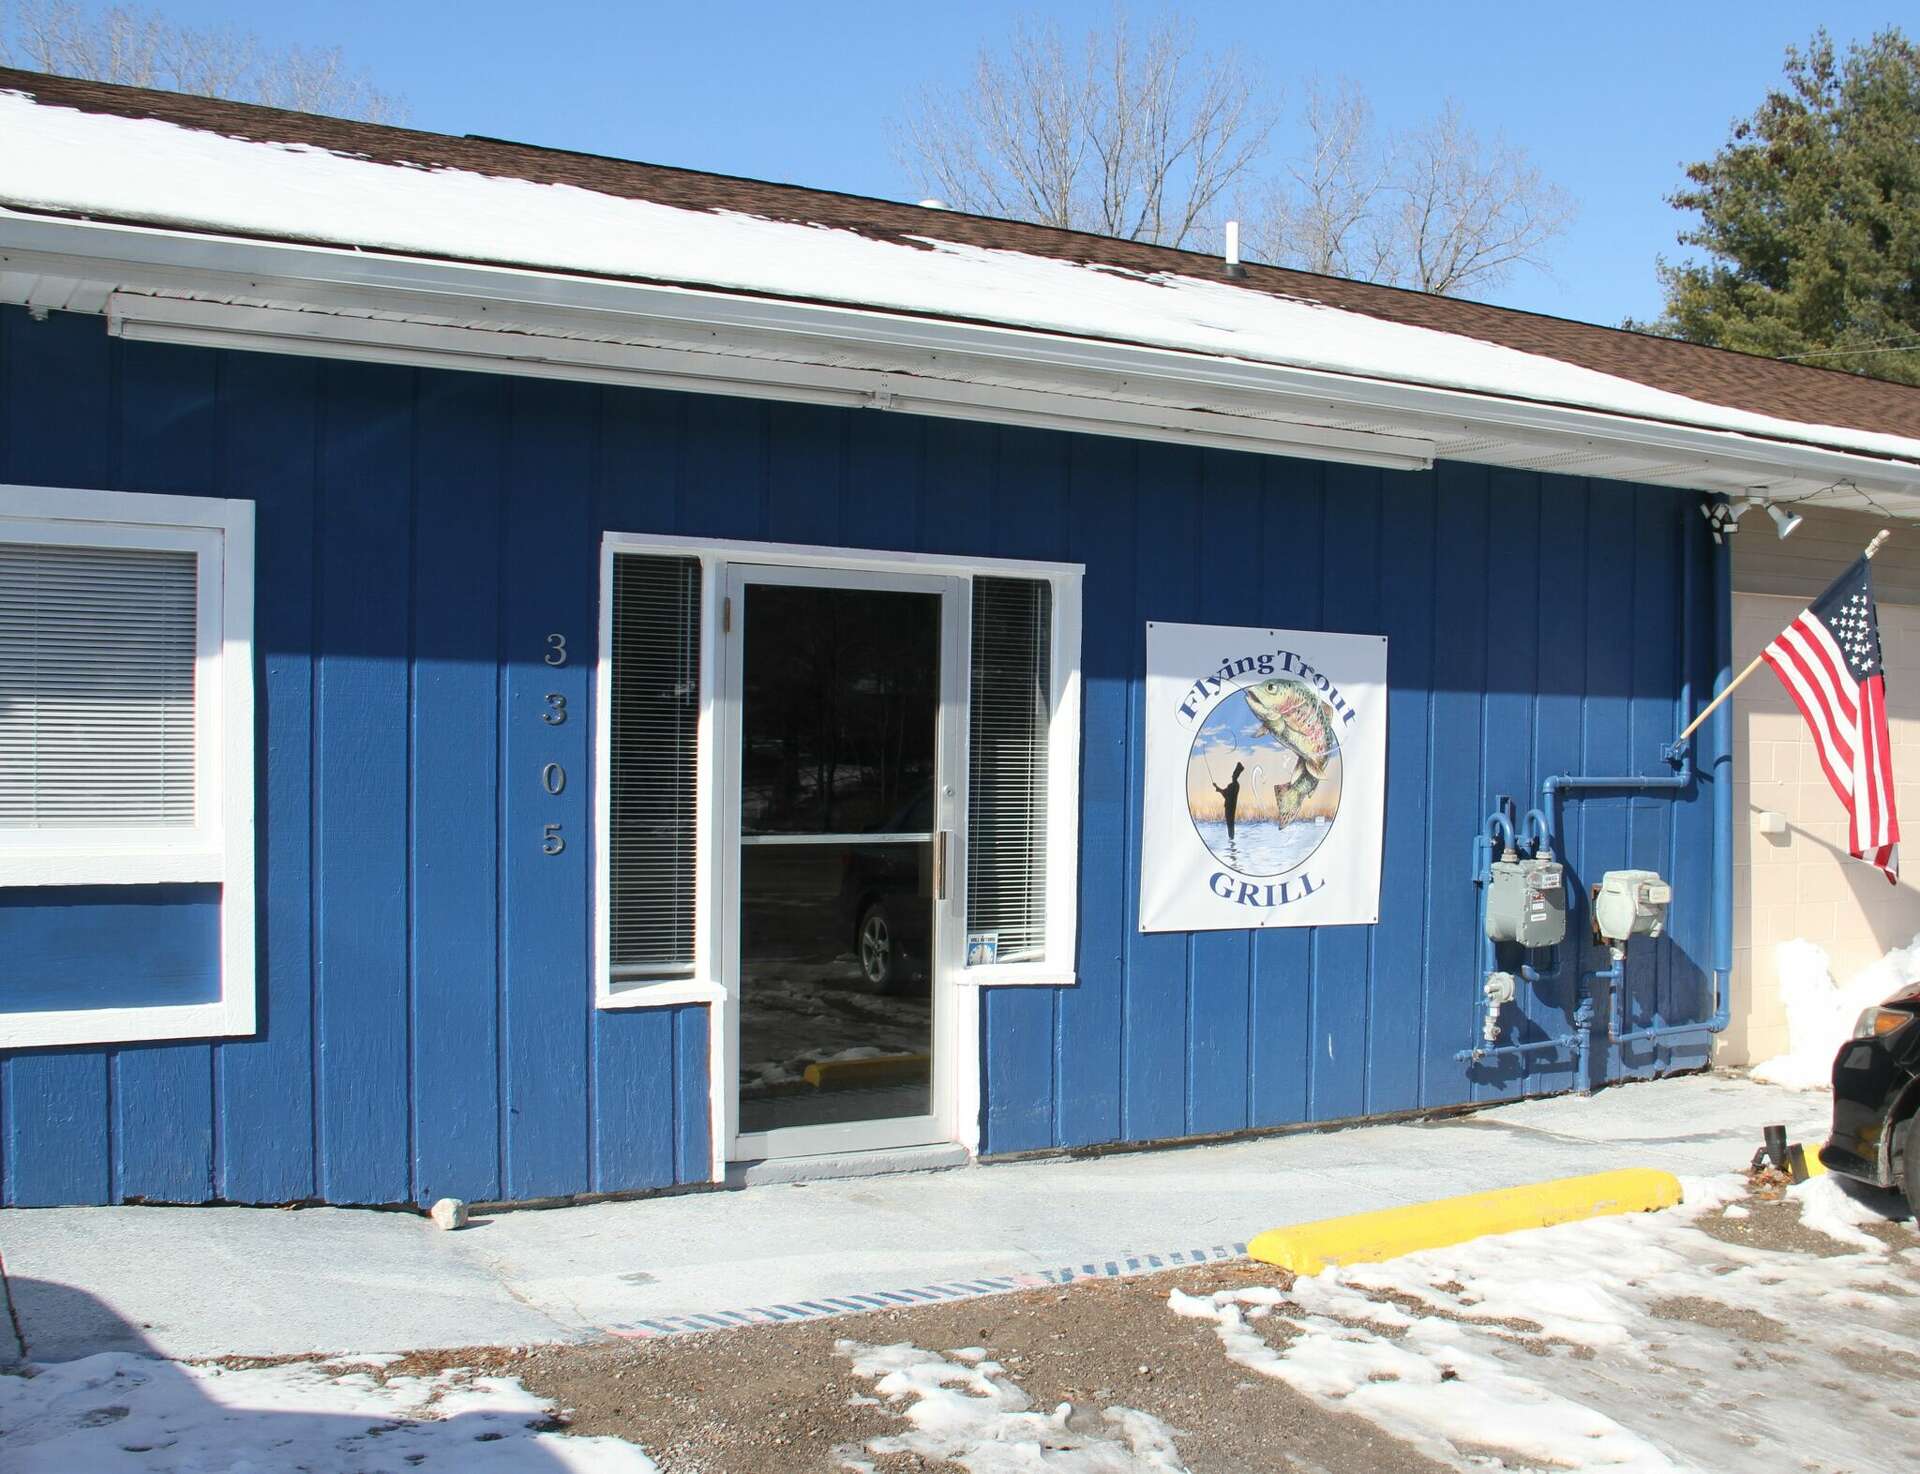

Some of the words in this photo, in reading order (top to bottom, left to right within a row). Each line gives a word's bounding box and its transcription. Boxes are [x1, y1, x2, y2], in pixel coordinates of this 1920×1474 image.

[1178, 654, 1275, 721] Flying
[1277, 650, 1356, 728] Trout
[543, 633, 567, 855] 3305
[1209, 872, 1325, 907] GRILL
